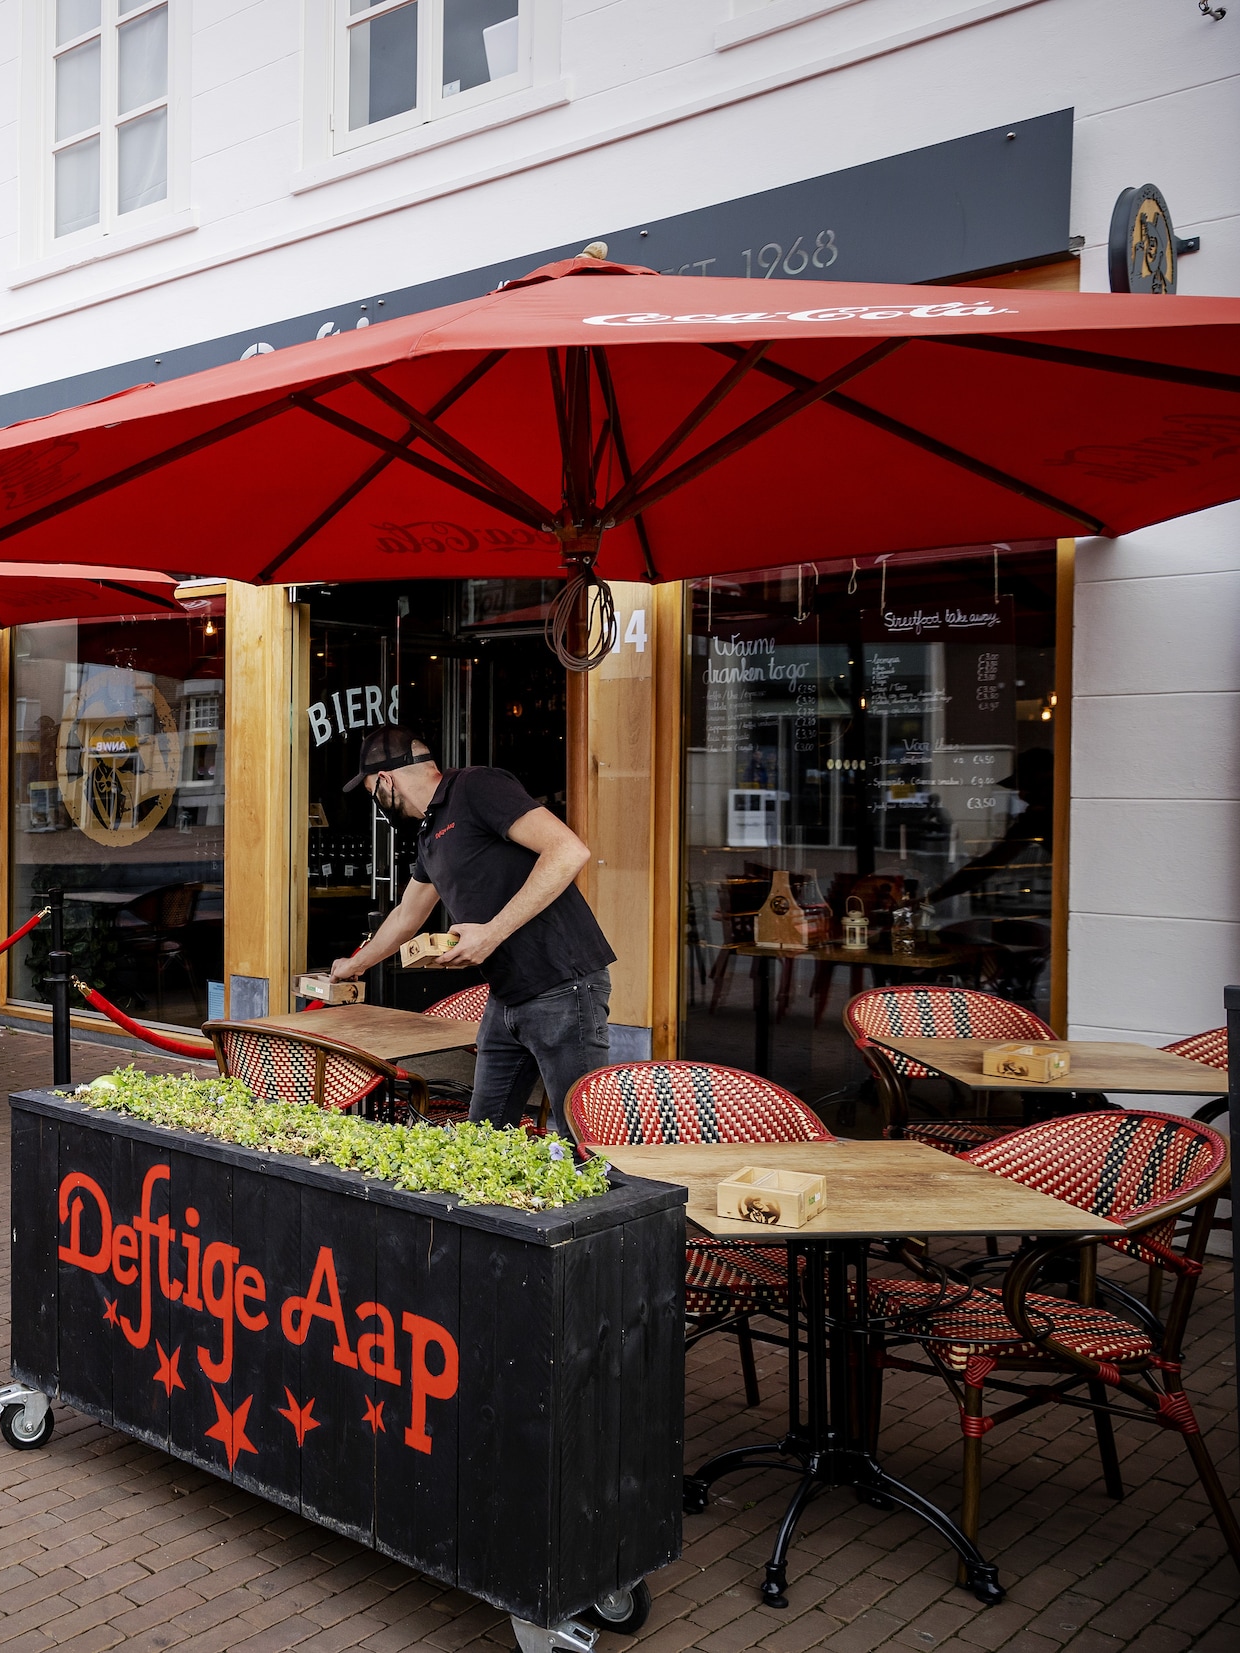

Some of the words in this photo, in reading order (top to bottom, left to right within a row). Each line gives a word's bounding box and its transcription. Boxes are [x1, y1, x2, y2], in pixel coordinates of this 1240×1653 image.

[741, 229, 838, 280] 1968
[713, 632, 776, 657] Warme
[702, 656, 766, 685] dranken
[767, 656, 786, 681] to
[786, 662, 810, 693] go
[58, 1164, 270, 1384] Deftige
[281, 1246, 459, 1455] Aap
